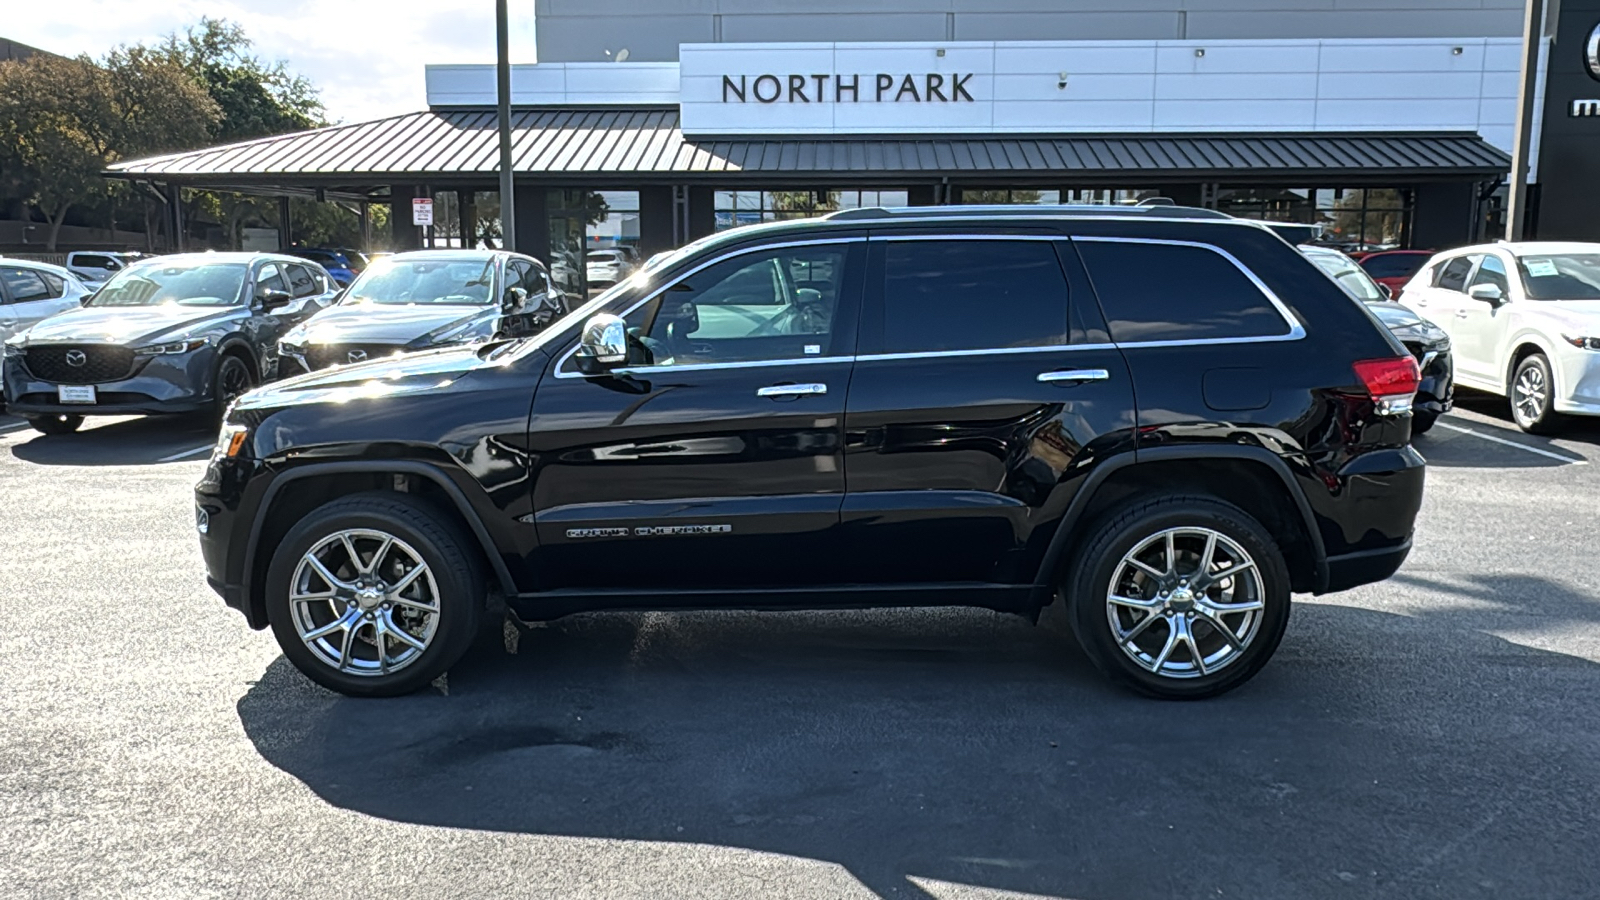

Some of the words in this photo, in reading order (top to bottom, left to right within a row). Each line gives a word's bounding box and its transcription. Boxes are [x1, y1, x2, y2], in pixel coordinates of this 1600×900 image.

[722, 74, 859, 103] NORTH
[876, 73, 975, 102] PARK
[566, 528, 629, 538] GRAND
[634, 524, 732, 535] CHEROKEE
